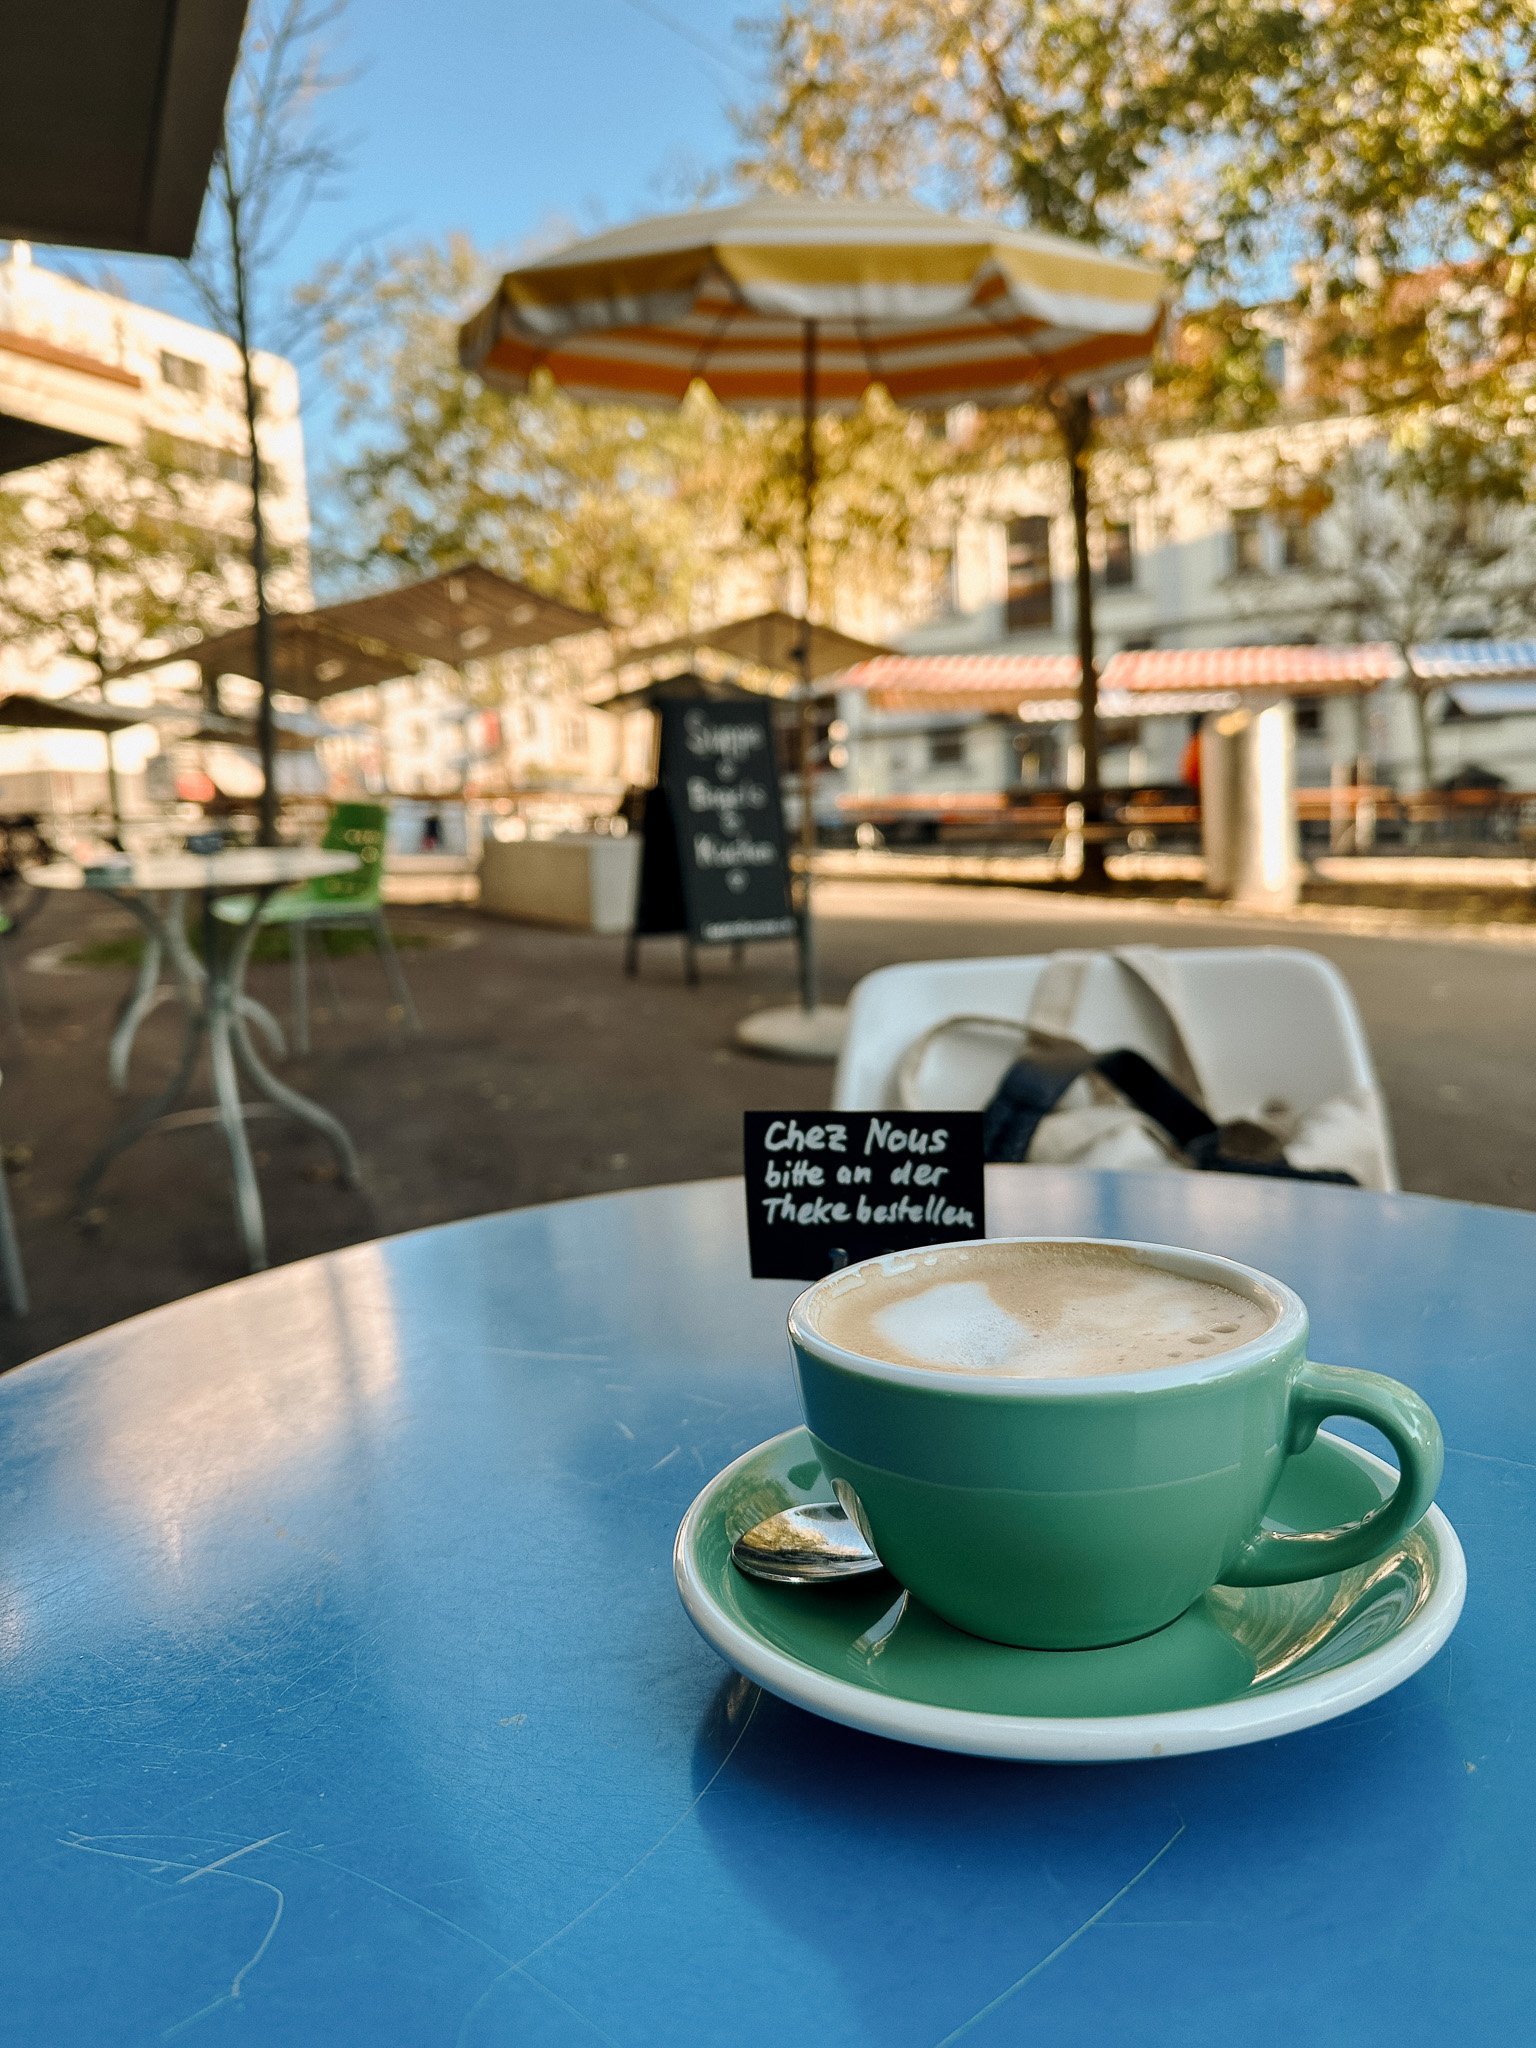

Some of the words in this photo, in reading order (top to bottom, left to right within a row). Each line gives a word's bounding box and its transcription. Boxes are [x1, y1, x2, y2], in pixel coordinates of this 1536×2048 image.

[764, 1119, 848, 1152] Chez
[864, 1117, 949, 1155] Nous
[764, 1159, 826, 1188] bitte
[836, 1165, 872, 1185] an
[890, 1160, 949, 1187] der
[761, 1192, 853, 1225] Theke
[856, 1193, 976, 1229] bestellen
